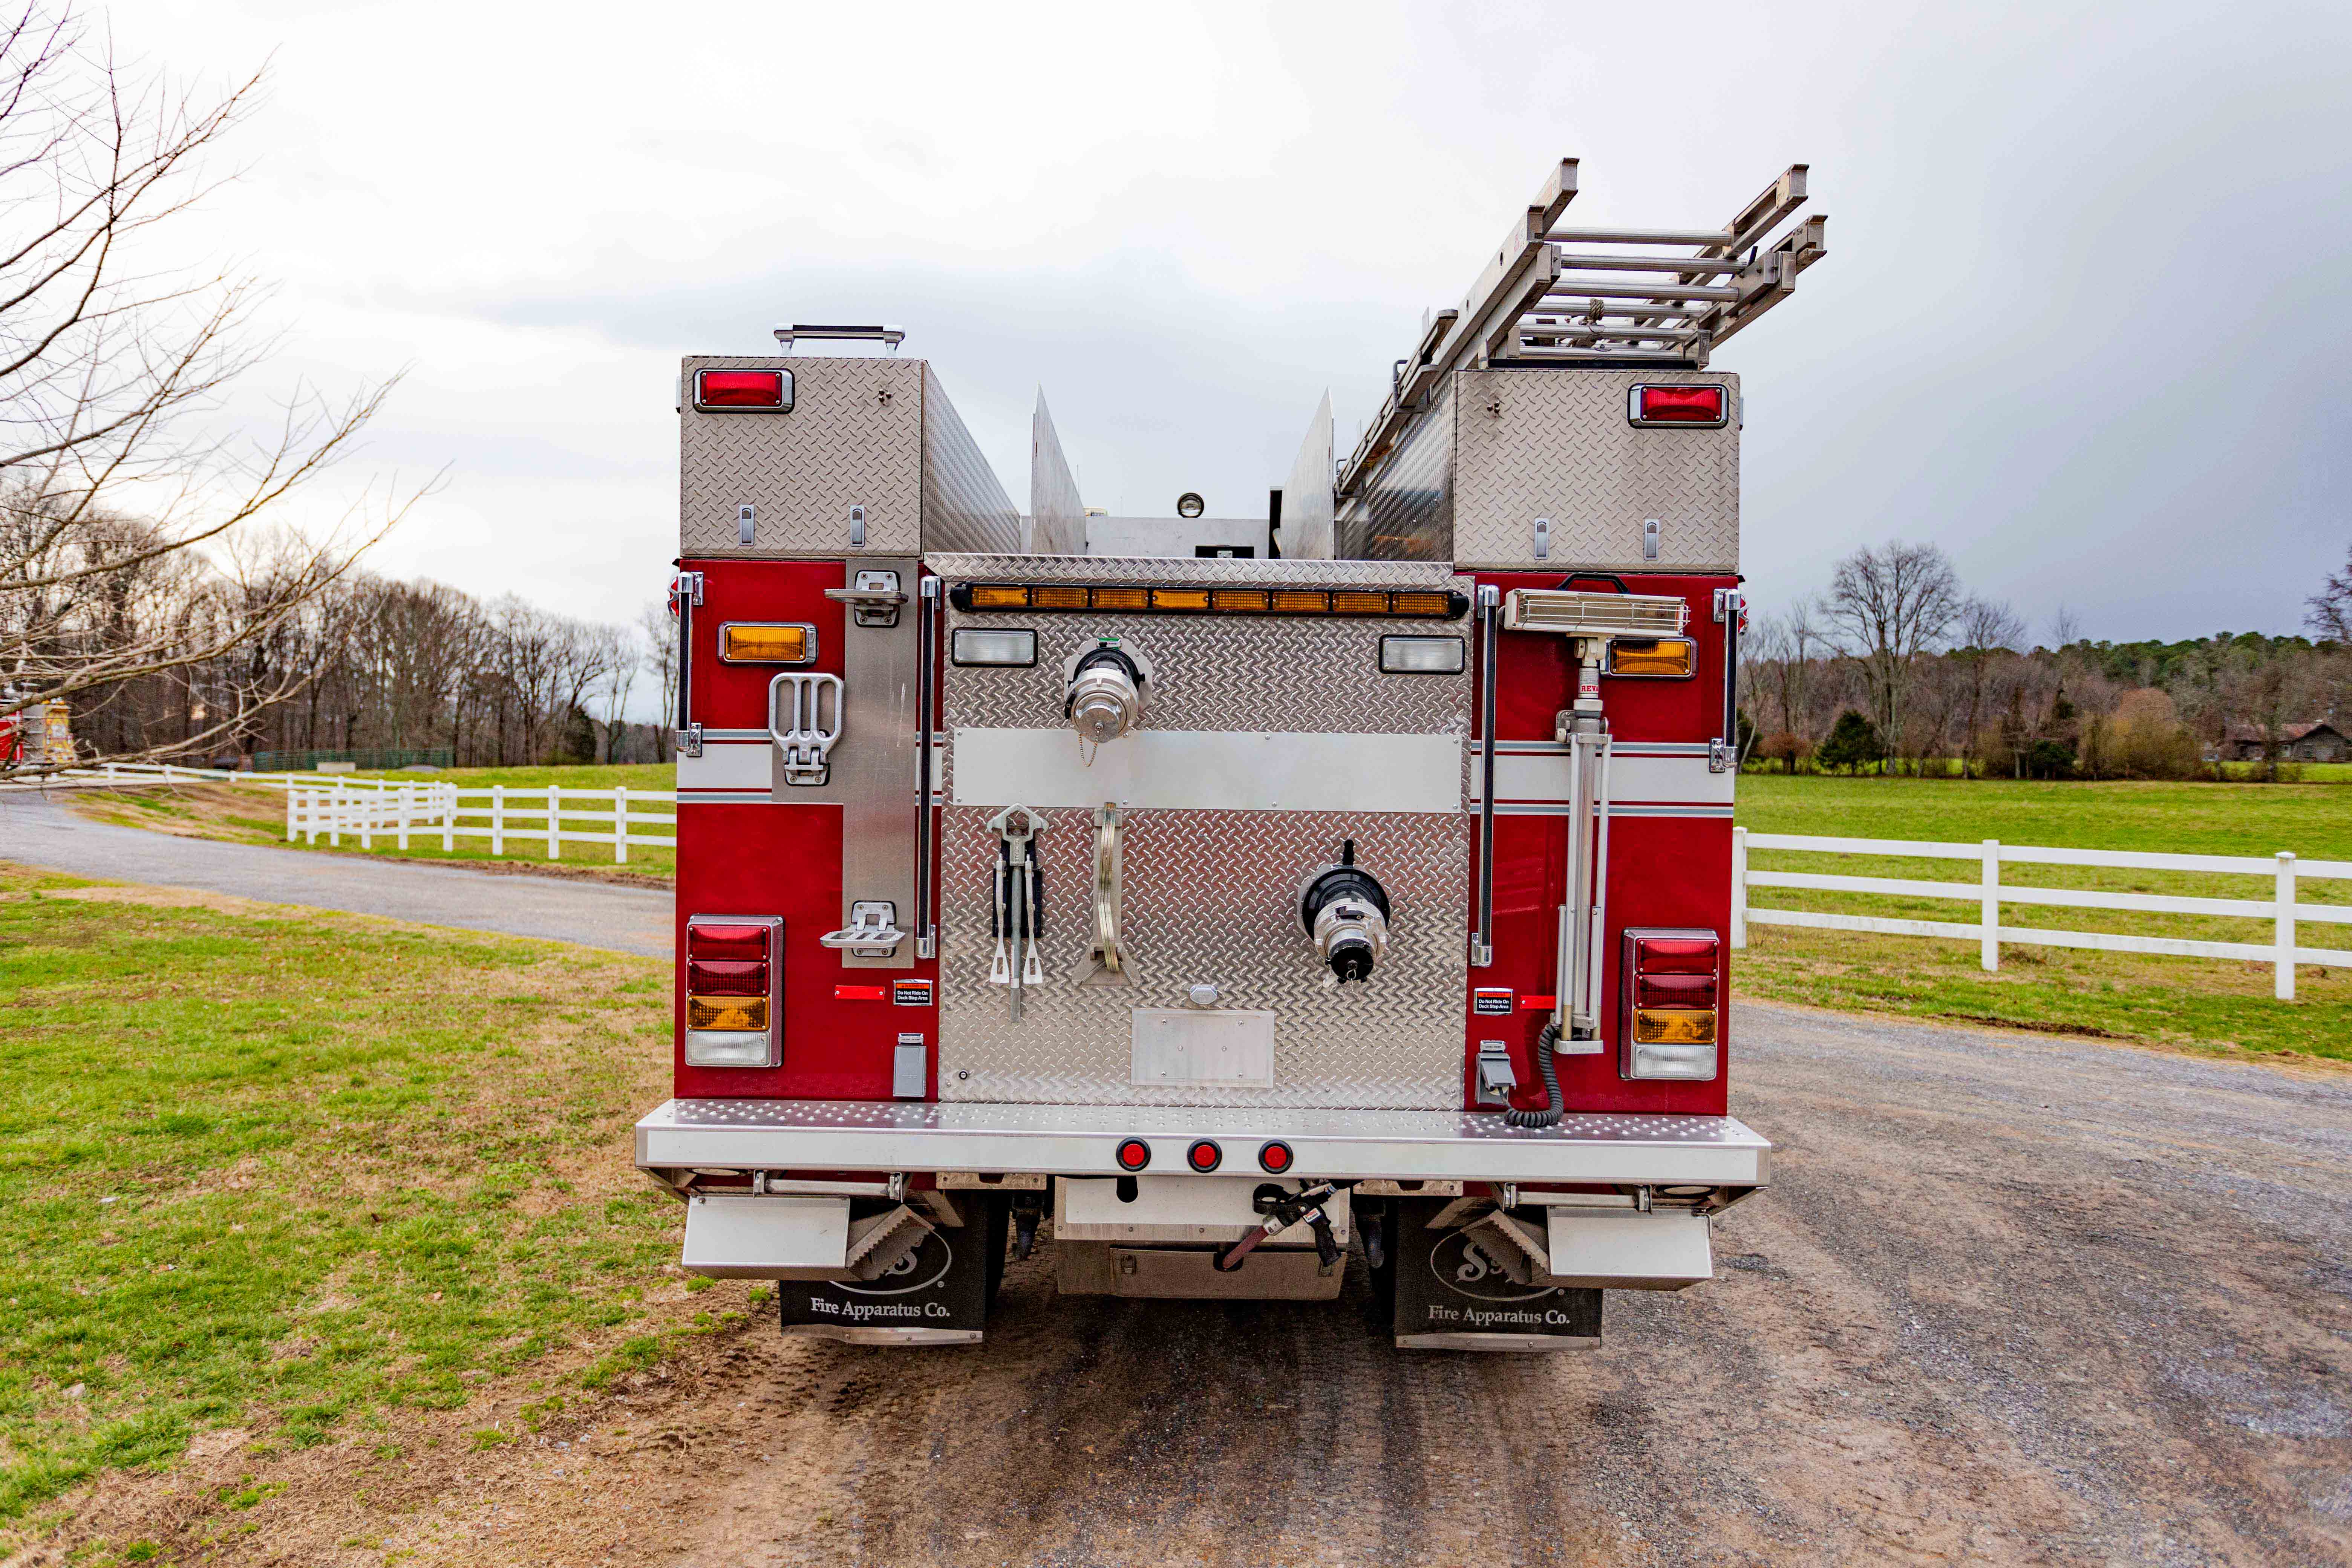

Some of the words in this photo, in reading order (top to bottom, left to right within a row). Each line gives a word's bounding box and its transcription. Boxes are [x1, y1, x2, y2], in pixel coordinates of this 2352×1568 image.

[810, 1297, 839, 1314] Fire
[842, 1301, 921, 1320] Apparatus
[925, 1302, 951, 1317] Co.
[1429, 1305, 1459, 1320] Fire
[1464, 1307, 1542, 1326] Apparatus
[1545, 1309, 1570, 1324] Co.
